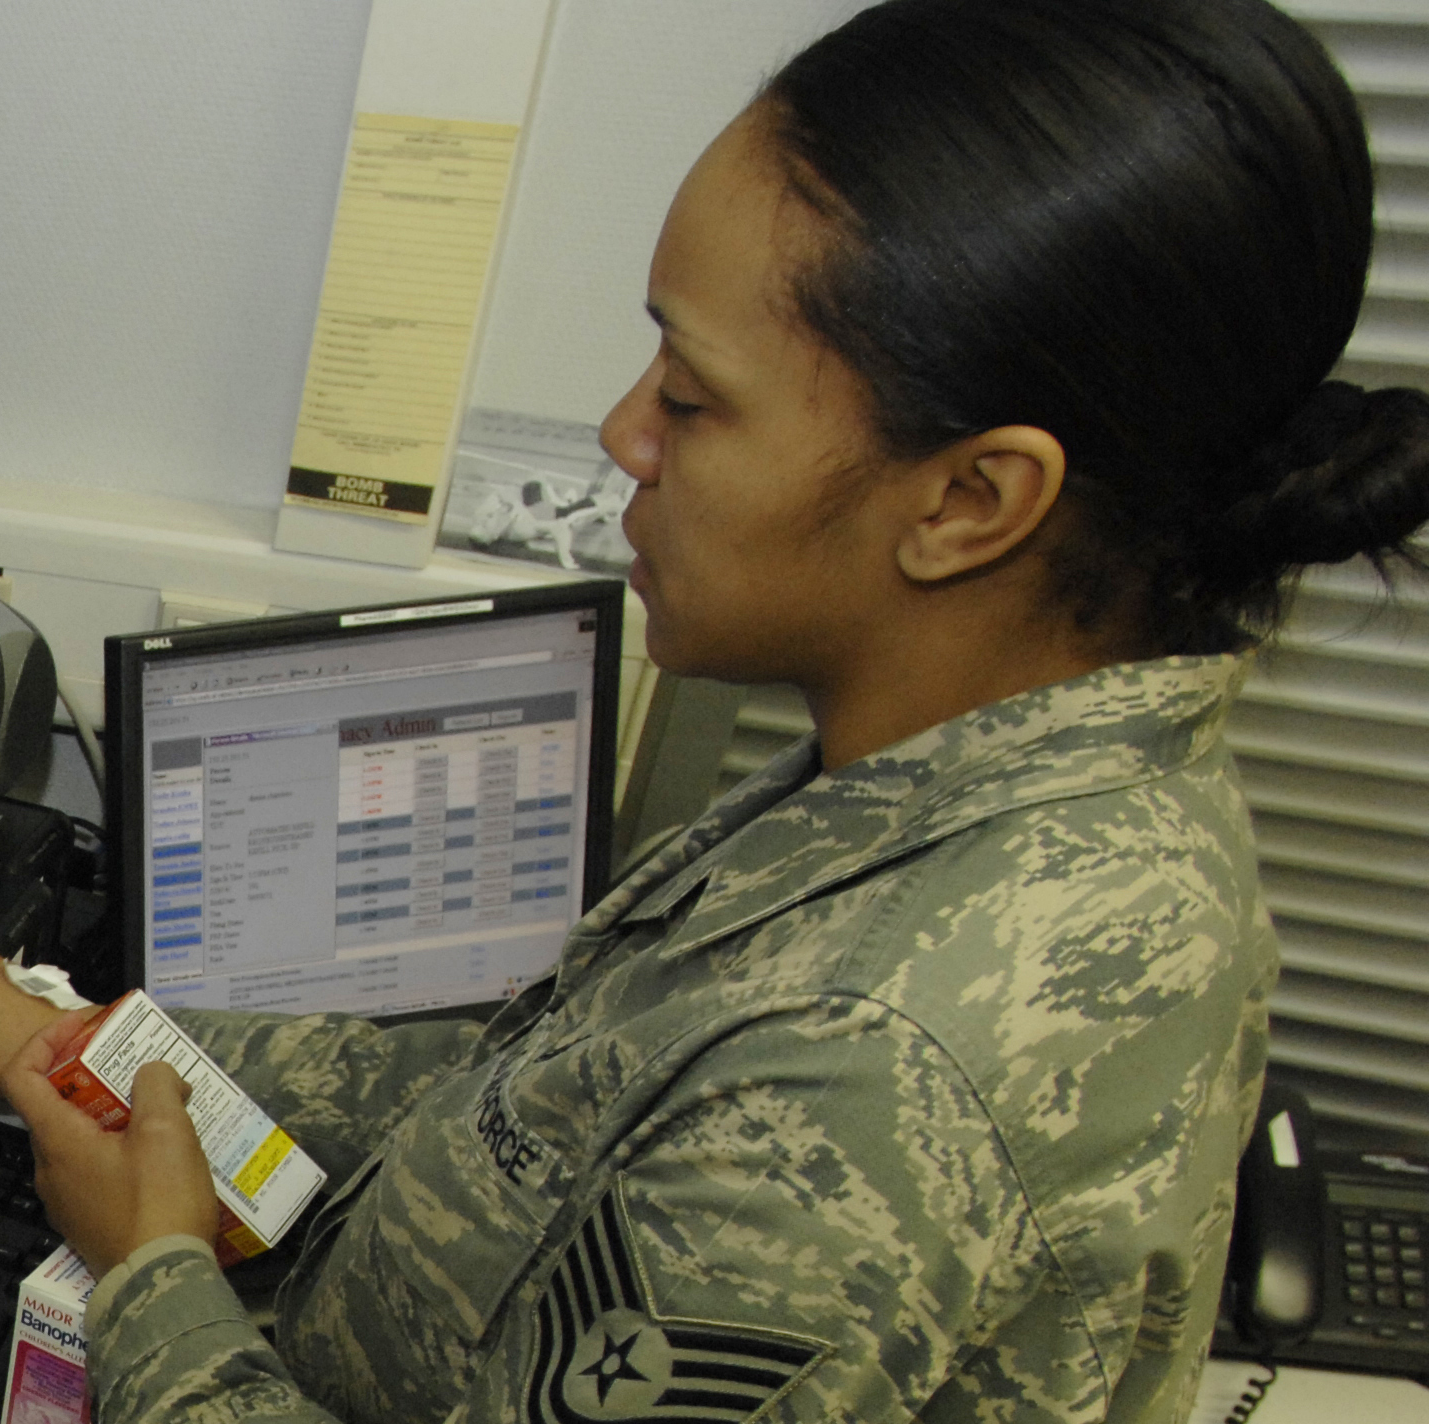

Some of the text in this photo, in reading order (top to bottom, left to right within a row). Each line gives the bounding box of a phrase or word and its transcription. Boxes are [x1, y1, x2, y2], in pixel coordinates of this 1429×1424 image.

[334, 474, 385, 495] BOMB
[327, 487, 389, 509] THREAT
[144, 636, 173, 651] DELL
[382, 715, 438, 738] Admin
[103, 1040, 136, 1078] Drug Facts
[23, 1295, 74, 1327] MAJOR
